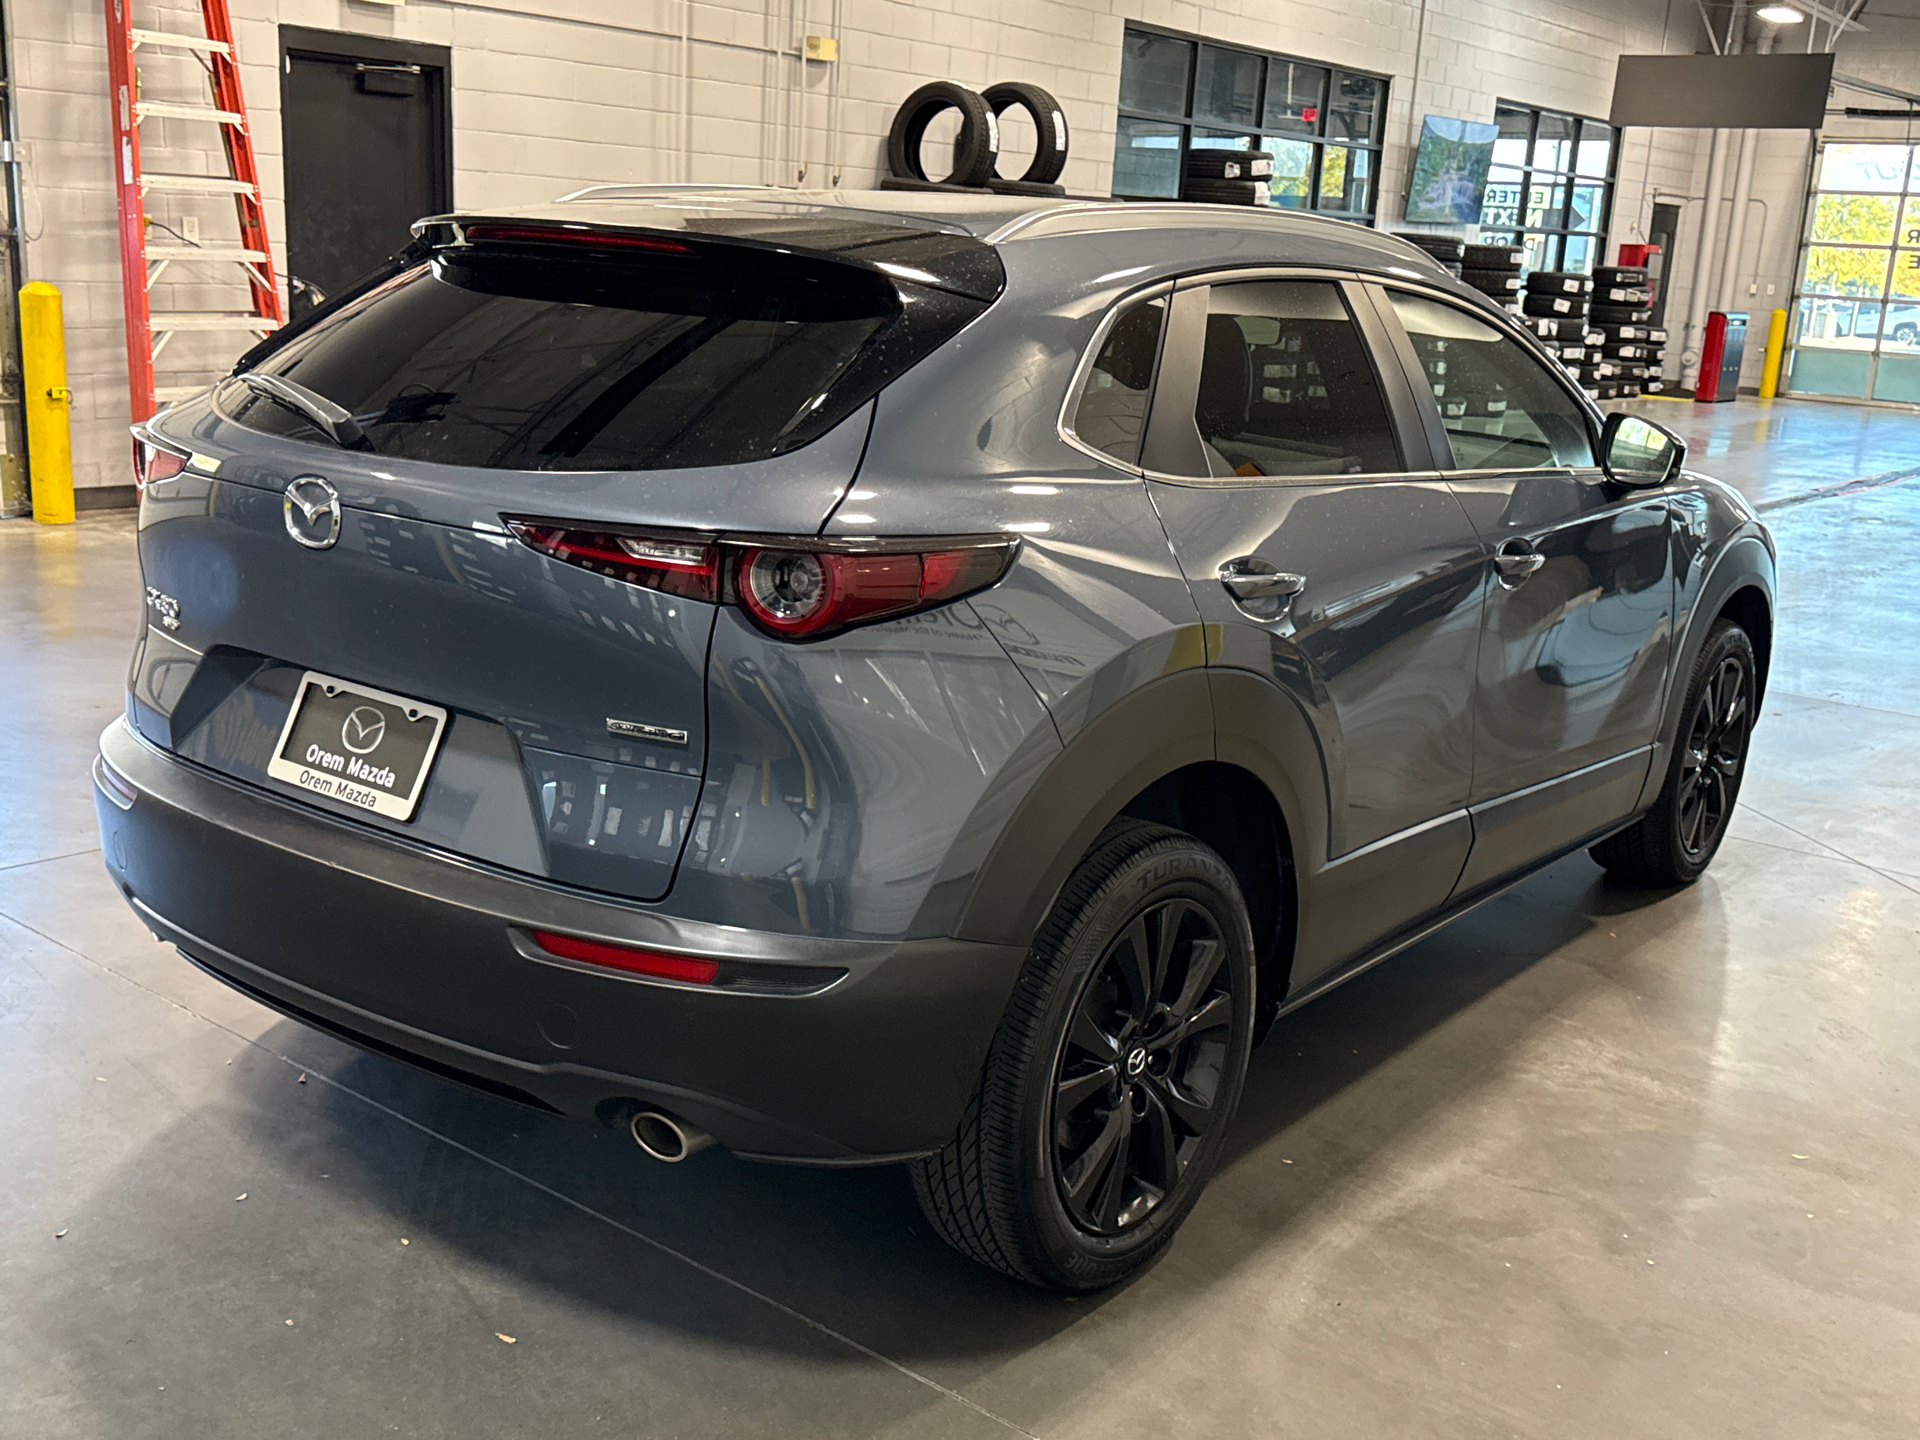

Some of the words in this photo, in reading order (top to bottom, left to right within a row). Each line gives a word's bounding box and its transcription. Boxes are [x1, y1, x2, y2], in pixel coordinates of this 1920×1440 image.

[306, 743, 345, 771] Orem
[346, 756, 396, 789] Mazda
[299, 770, 333, 793] Orem
[335, 782, 377, 808] Mazda
[1136, 856, 1233, 892] TURANZA
